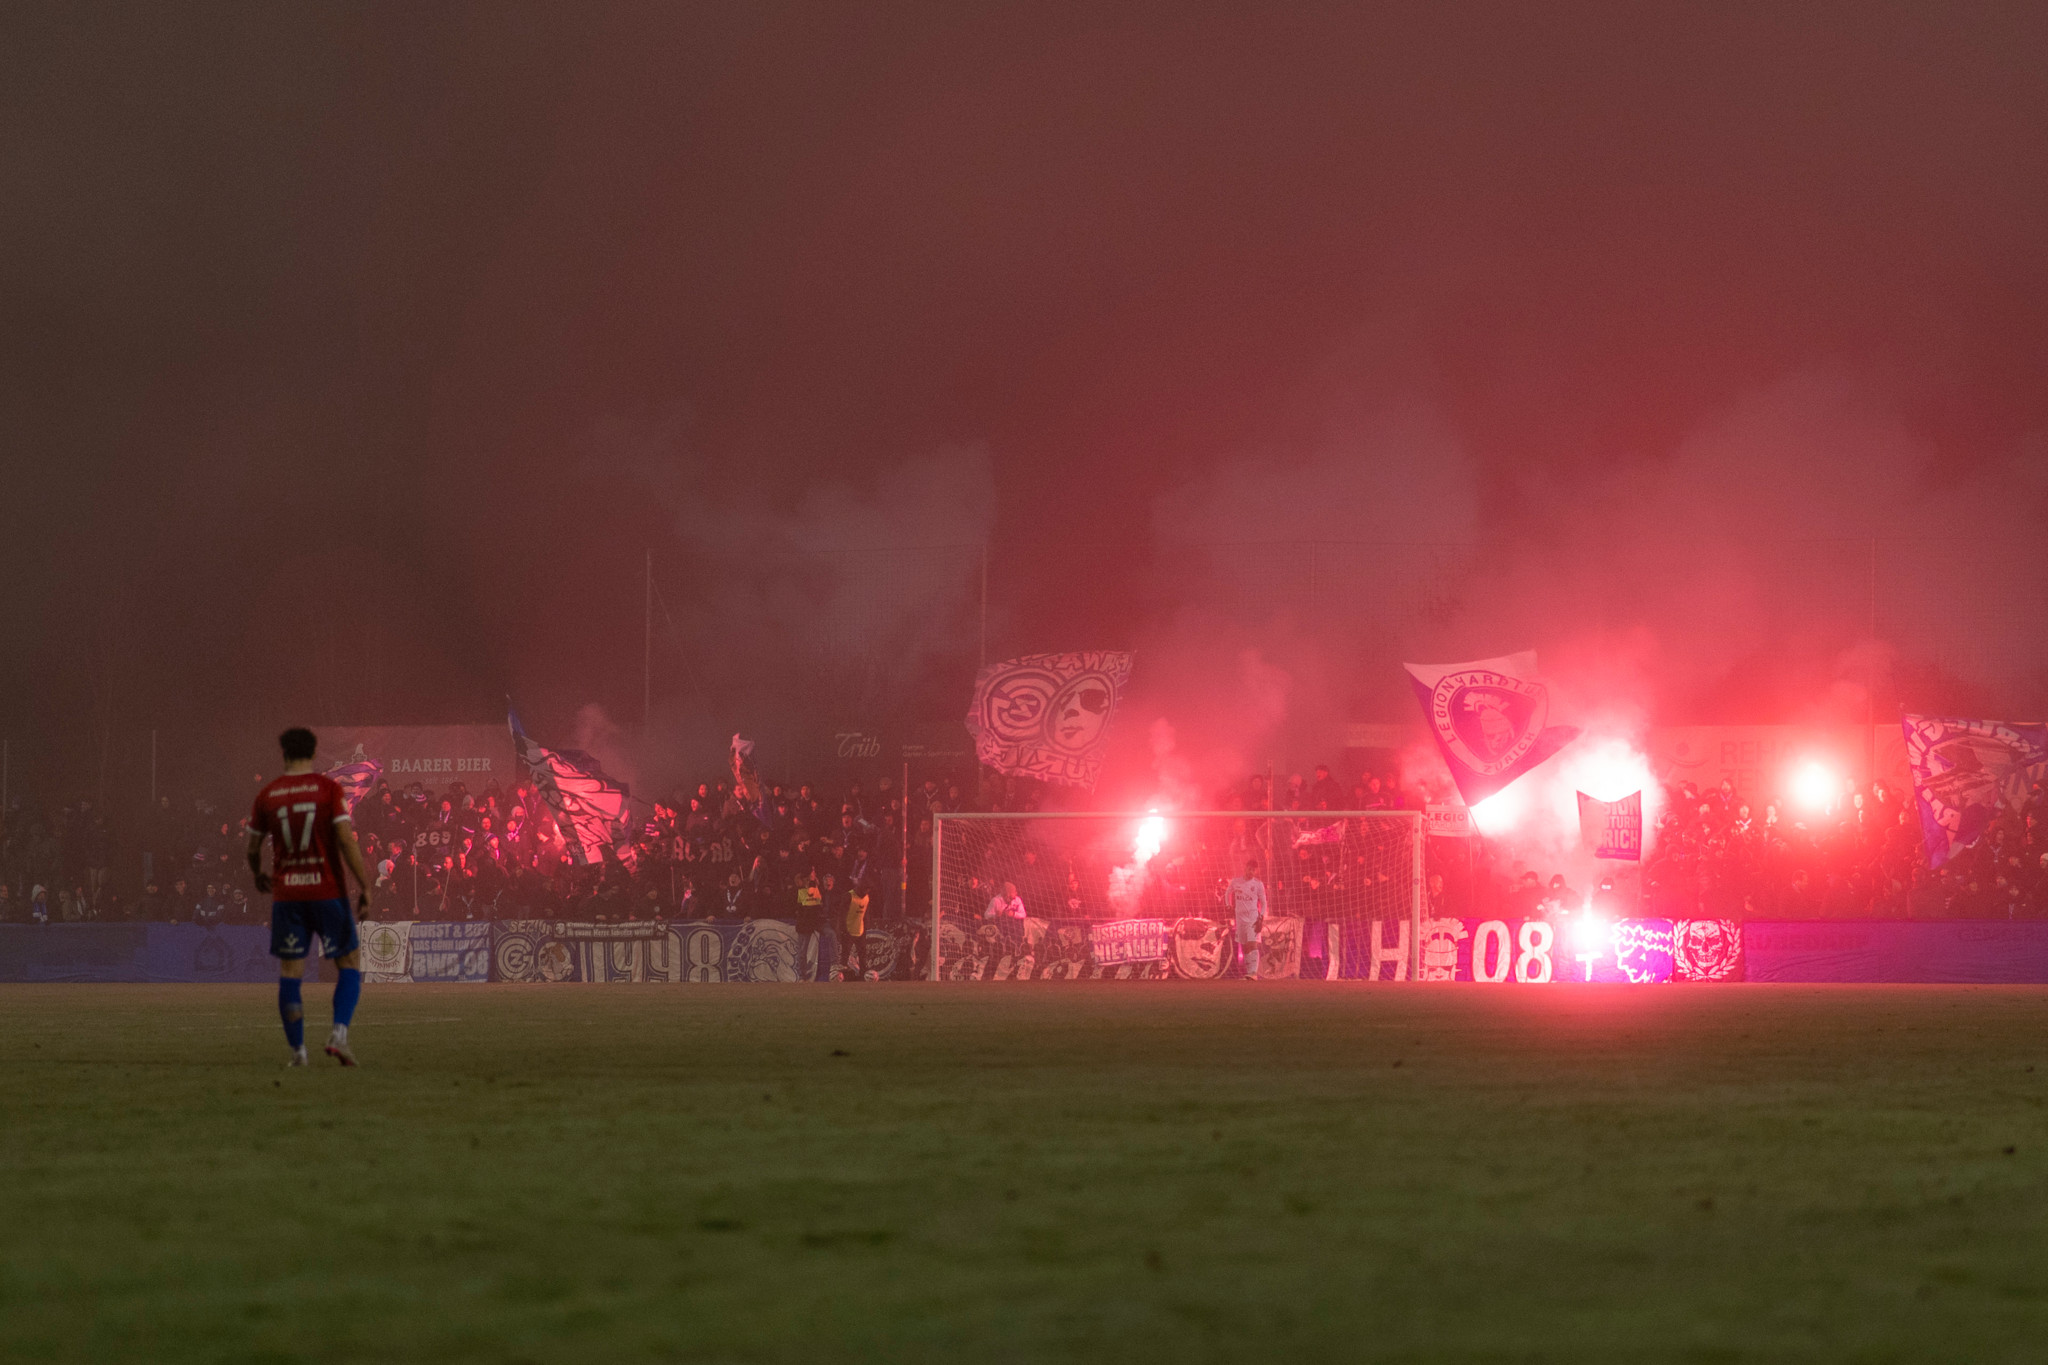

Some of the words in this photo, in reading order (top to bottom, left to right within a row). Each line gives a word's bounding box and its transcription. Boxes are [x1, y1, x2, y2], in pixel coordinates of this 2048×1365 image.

[834, 732, 881, 758] Trüb
[391, 759, 453, 773] BAARER
[457, 758, 492, 772] BIER
[276, 802, 315, 854] 17
[464, 950, 489, 977] 98
[1472, 919, 1553, 983] 08
